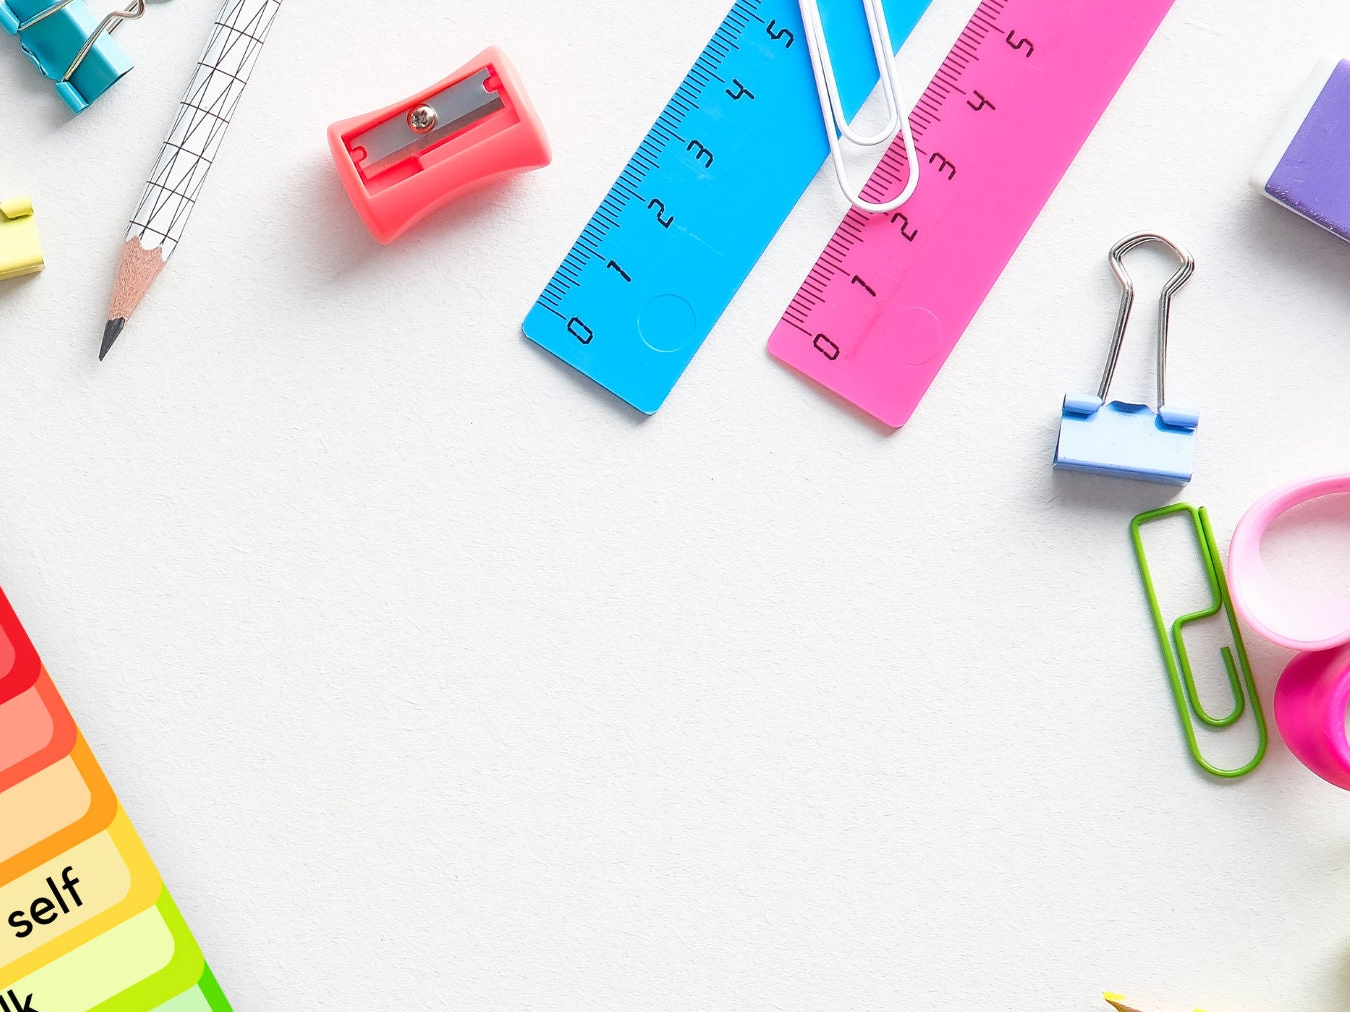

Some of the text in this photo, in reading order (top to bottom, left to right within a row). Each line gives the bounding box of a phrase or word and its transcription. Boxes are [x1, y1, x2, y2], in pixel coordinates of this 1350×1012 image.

[567, 19, 794, 345] 0 1 2 3 4 5
[813, 29, 1035, 361] 0 1 2 3 4 5
[7, 866, 83, 938] self
